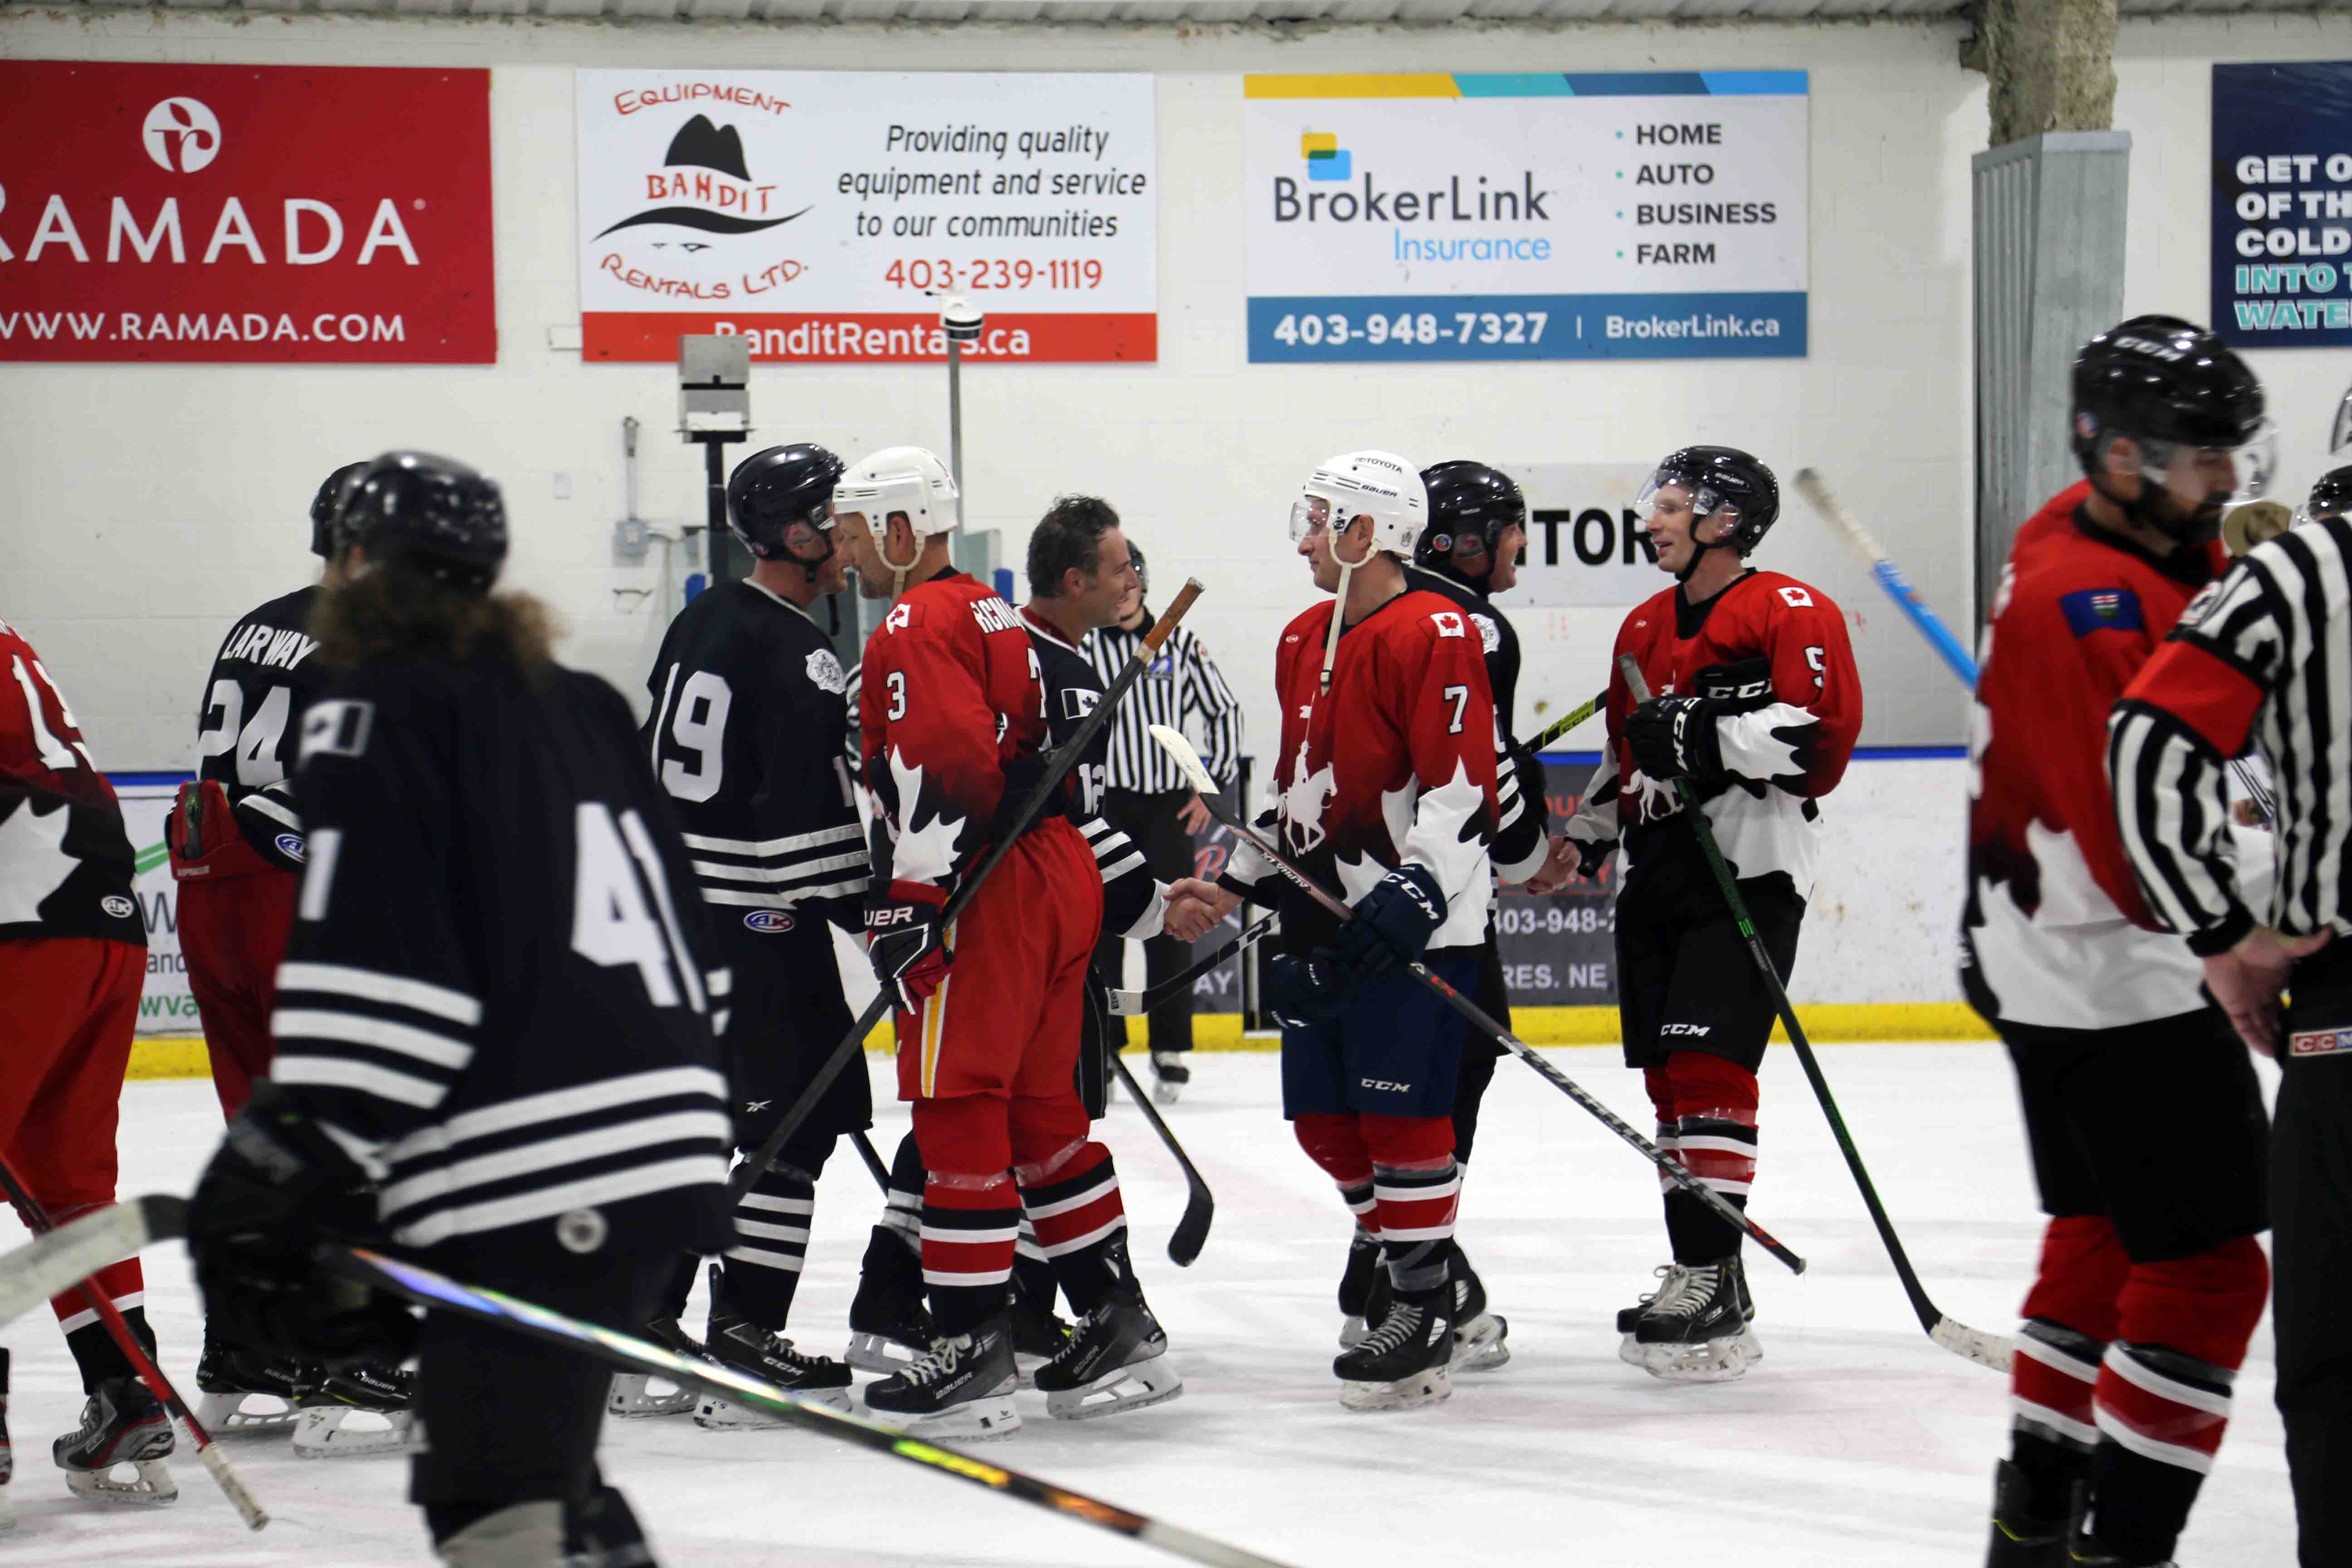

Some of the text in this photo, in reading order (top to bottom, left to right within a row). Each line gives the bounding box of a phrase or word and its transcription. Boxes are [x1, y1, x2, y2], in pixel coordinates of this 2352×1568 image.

[614, 83, 791, 115] EQUIPMENT
[887, 125, 1109, 161] Providing quality
[1637, 124, 1722, 145] HOME
[838, 167, 1146, 201] equipment and service
[1636, 163, 1715, 185] AUTO
[2236, 154, 2318, 185] GET
[647, 172, 777, 214] BANDIT
[1274, 171, 1550, 222] BrokerLink
[2235, 191, 2292, 220] OF
[856, 210, 1117, 237] to our communities
[1637, 203, 1777, 225] BUSINESS
[1394, 227, 1551, 261] Insurance
[1637, 243, 1716, 264] FARM
[2235, 227, 2351, 257] COLD
[601, 253, 808, 299] RENTALS LTD.
[885, 260, 1102, 289] 403-239-1119
[2235, 262, 2337, 294] INTO
[1274, 312, 1780, 346] 403-948-7327 BrokerLink.ca
[2233, 298, 2352, 330] WATE
[715, 321, 1030, 355] anditRentas.ca
[1367, 458, 1403, 474] TOYOTA
[887, 672, 905, 720] 3
[1707, 679, 1772, 699] CC
[1444, 686, 1468, 734] 7
[197, 680, 290, 789] 24
[653, 662, 732, 803] 19
[1383, 872, 1439, 920] CCM
[1568, 963, 1607, 989] NE
[1661, 1024, 1710, 1037] CCM
[1361, 1078, 1411, 1093] CCM
